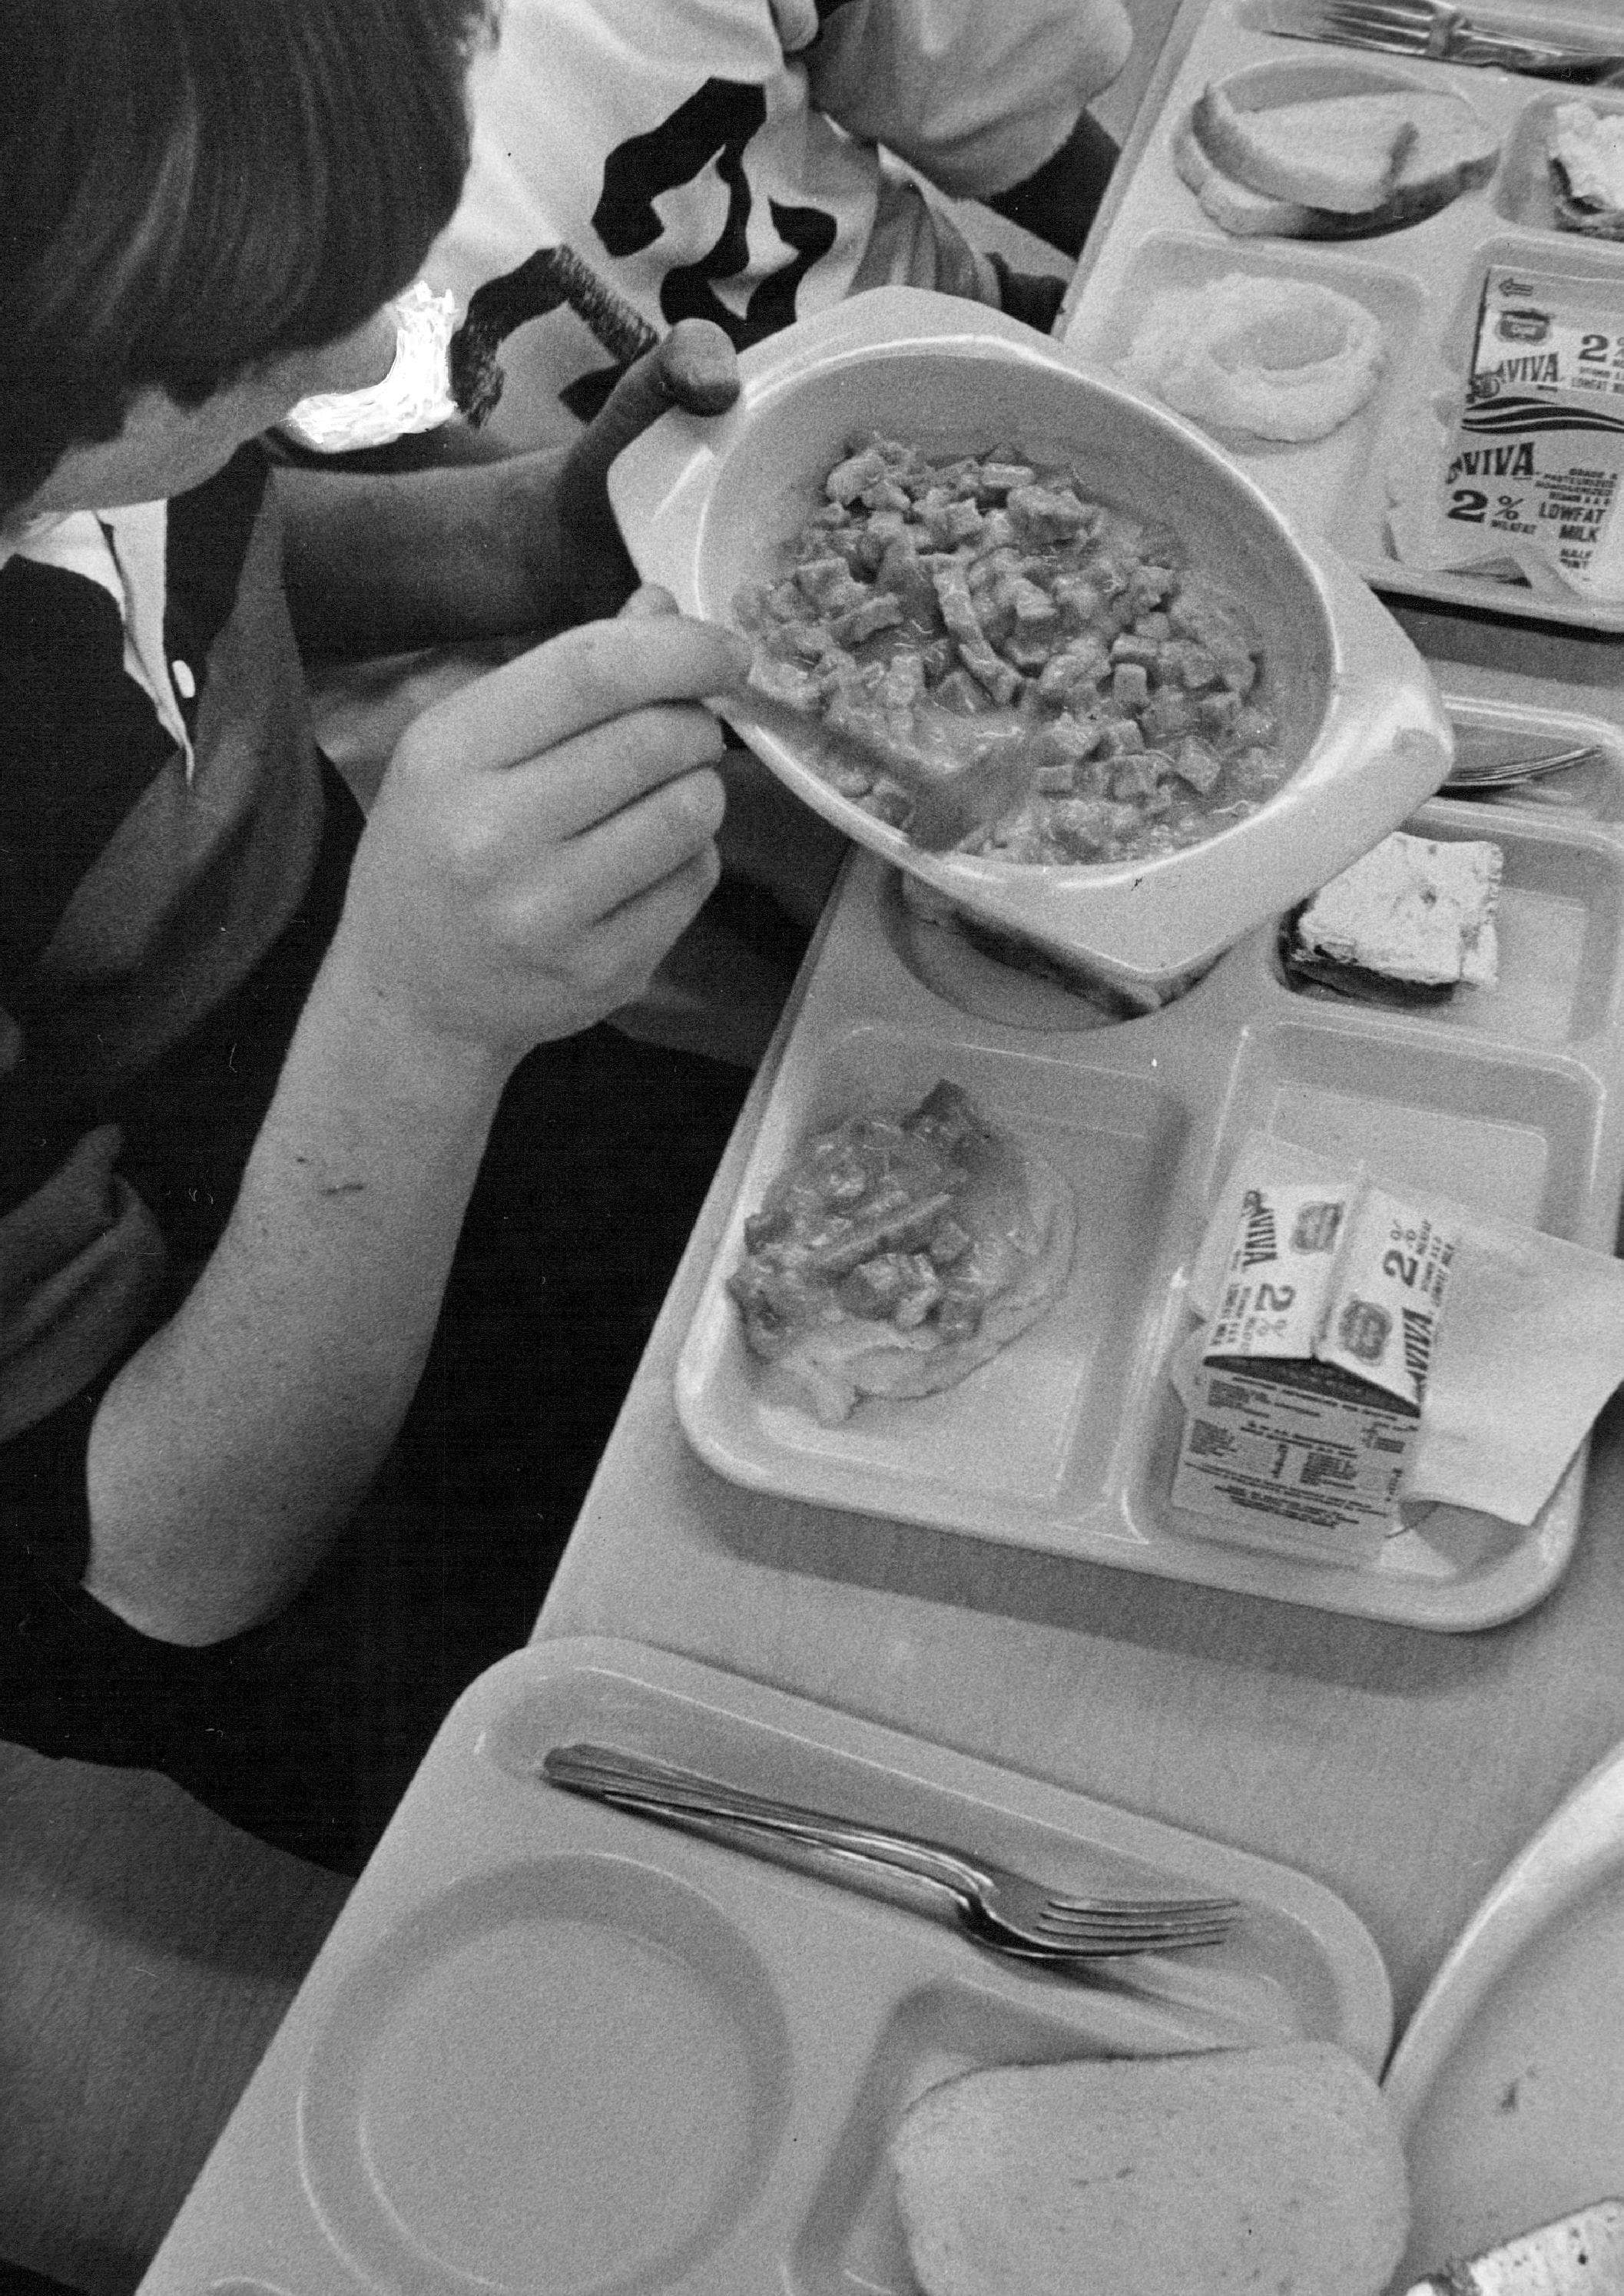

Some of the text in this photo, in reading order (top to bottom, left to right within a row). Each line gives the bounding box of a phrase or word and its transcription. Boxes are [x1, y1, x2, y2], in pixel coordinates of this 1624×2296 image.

[1500, 351, 1559, 383] VIVA
[1454, 442, 1535, 478] VIVA
[1539, 502, 1606, 524] LOWFAT
[1559, 524, 1600, 543] MILK
[1244, 1197, 1277, 1267] VIVA
[1402, 1307, 1433, 1376] VIVA
